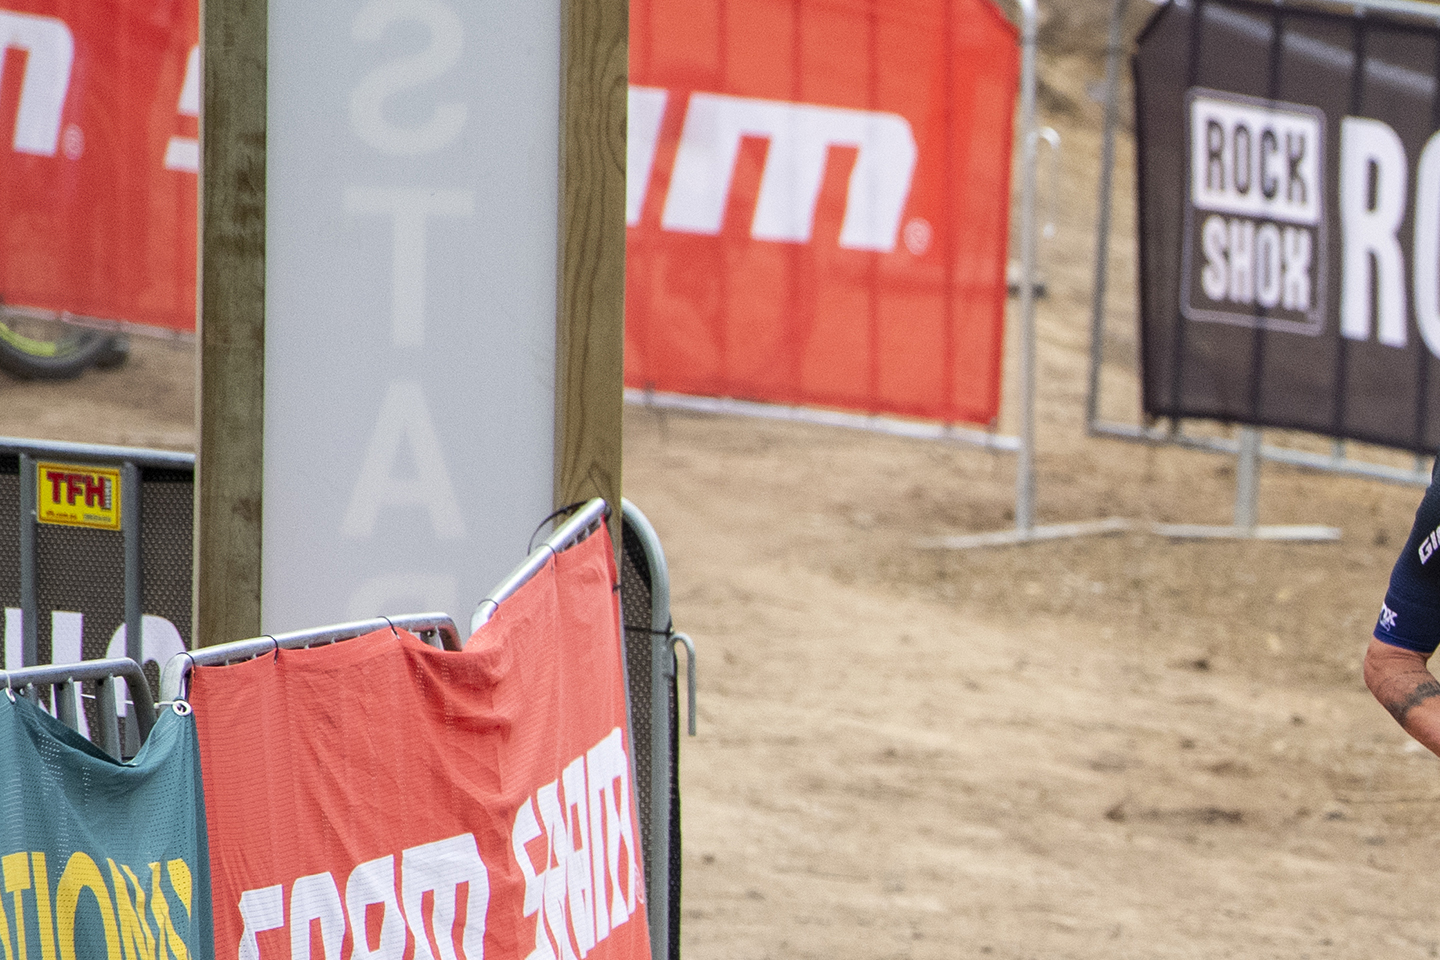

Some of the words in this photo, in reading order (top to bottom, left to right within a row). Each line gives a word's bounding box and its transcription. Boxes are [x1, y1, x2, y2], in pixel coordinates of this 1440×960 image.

[1206, 118, 1307, 205] ROCK
[1202, 214, 1312, 311] SHOX
[46, 471, 106, 508] TFH
